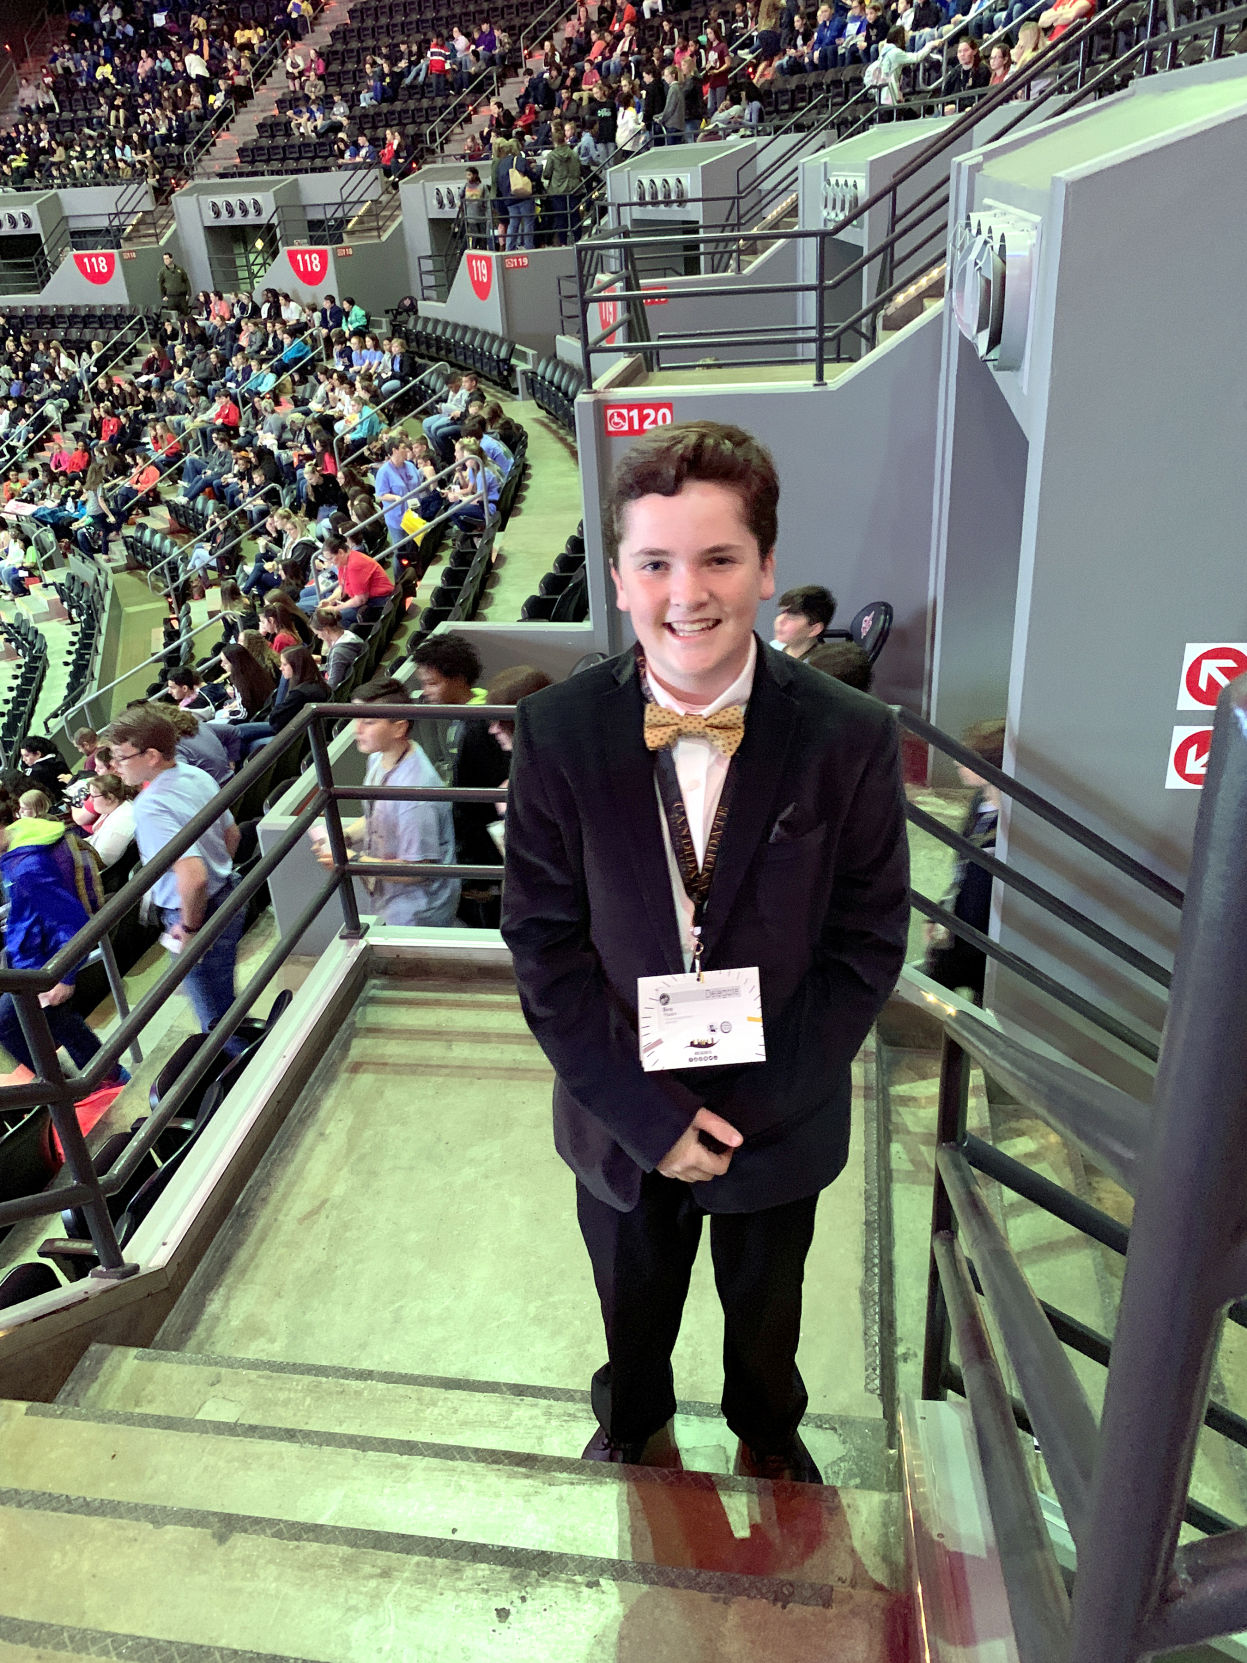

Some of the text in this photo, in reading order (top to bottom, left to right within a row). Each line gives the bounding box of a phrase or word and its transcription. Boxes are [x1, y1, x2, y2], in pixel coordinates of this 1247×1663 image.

[83, 256, 108, 273] 118
[297, 253, 321, 272] 118
[472, 259, 488, 283] 119
[513, 257, 529, 267] 119
[629, 408, 671, 430] 120
